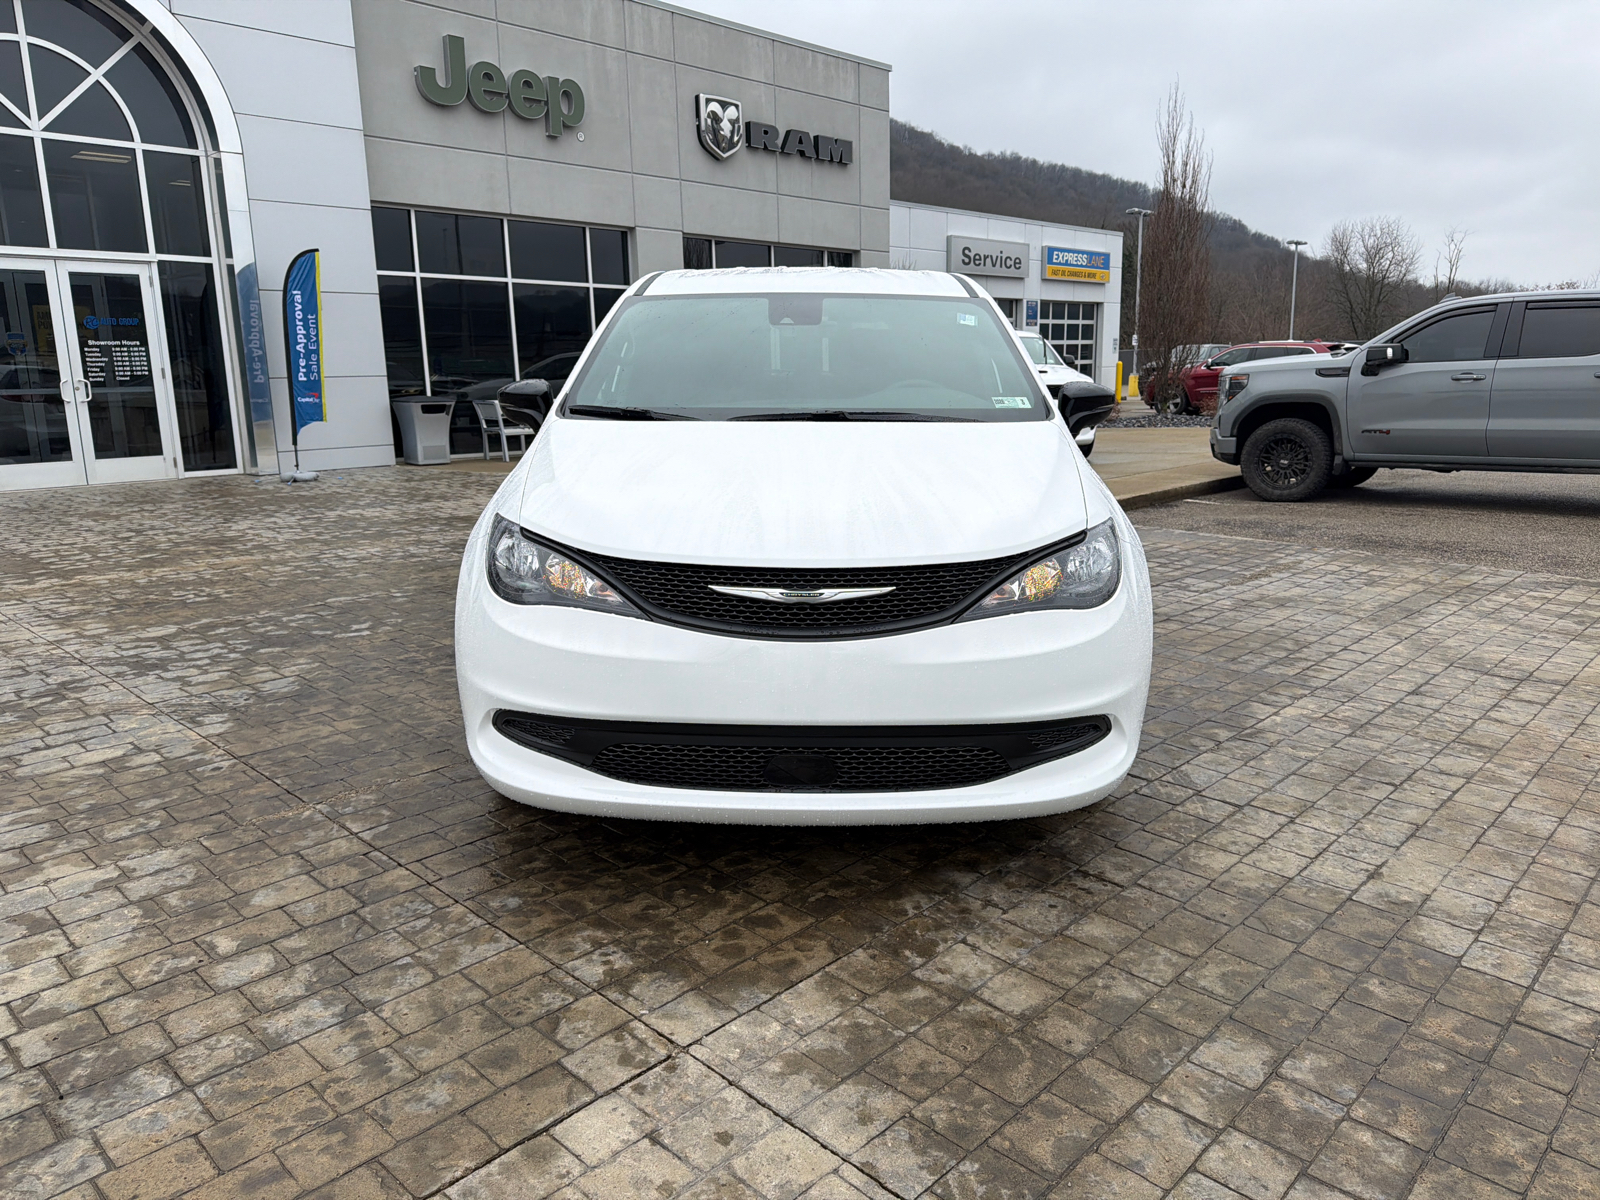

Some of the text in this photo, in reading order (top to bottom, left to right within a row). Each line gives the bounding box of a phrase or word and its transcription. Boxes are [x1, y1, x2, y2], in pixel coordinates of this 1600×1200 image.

[414, 34, 585, 138] Jeep
[745, 121, 853, 164] RAM
[961, 246, 1022, 271] Service
[1050, 268, 1061, 277] FAST
[1067, 270, 1084, 278] CHANGES
[1087, 272, 1098, 280] MORE
[101, 317, 117, 326] AUTO
[119, 317, 139, 326] GROUP
[291, 290, 307, 381] Pre-Approval
[307, 313, 318, 380] Sale Event
